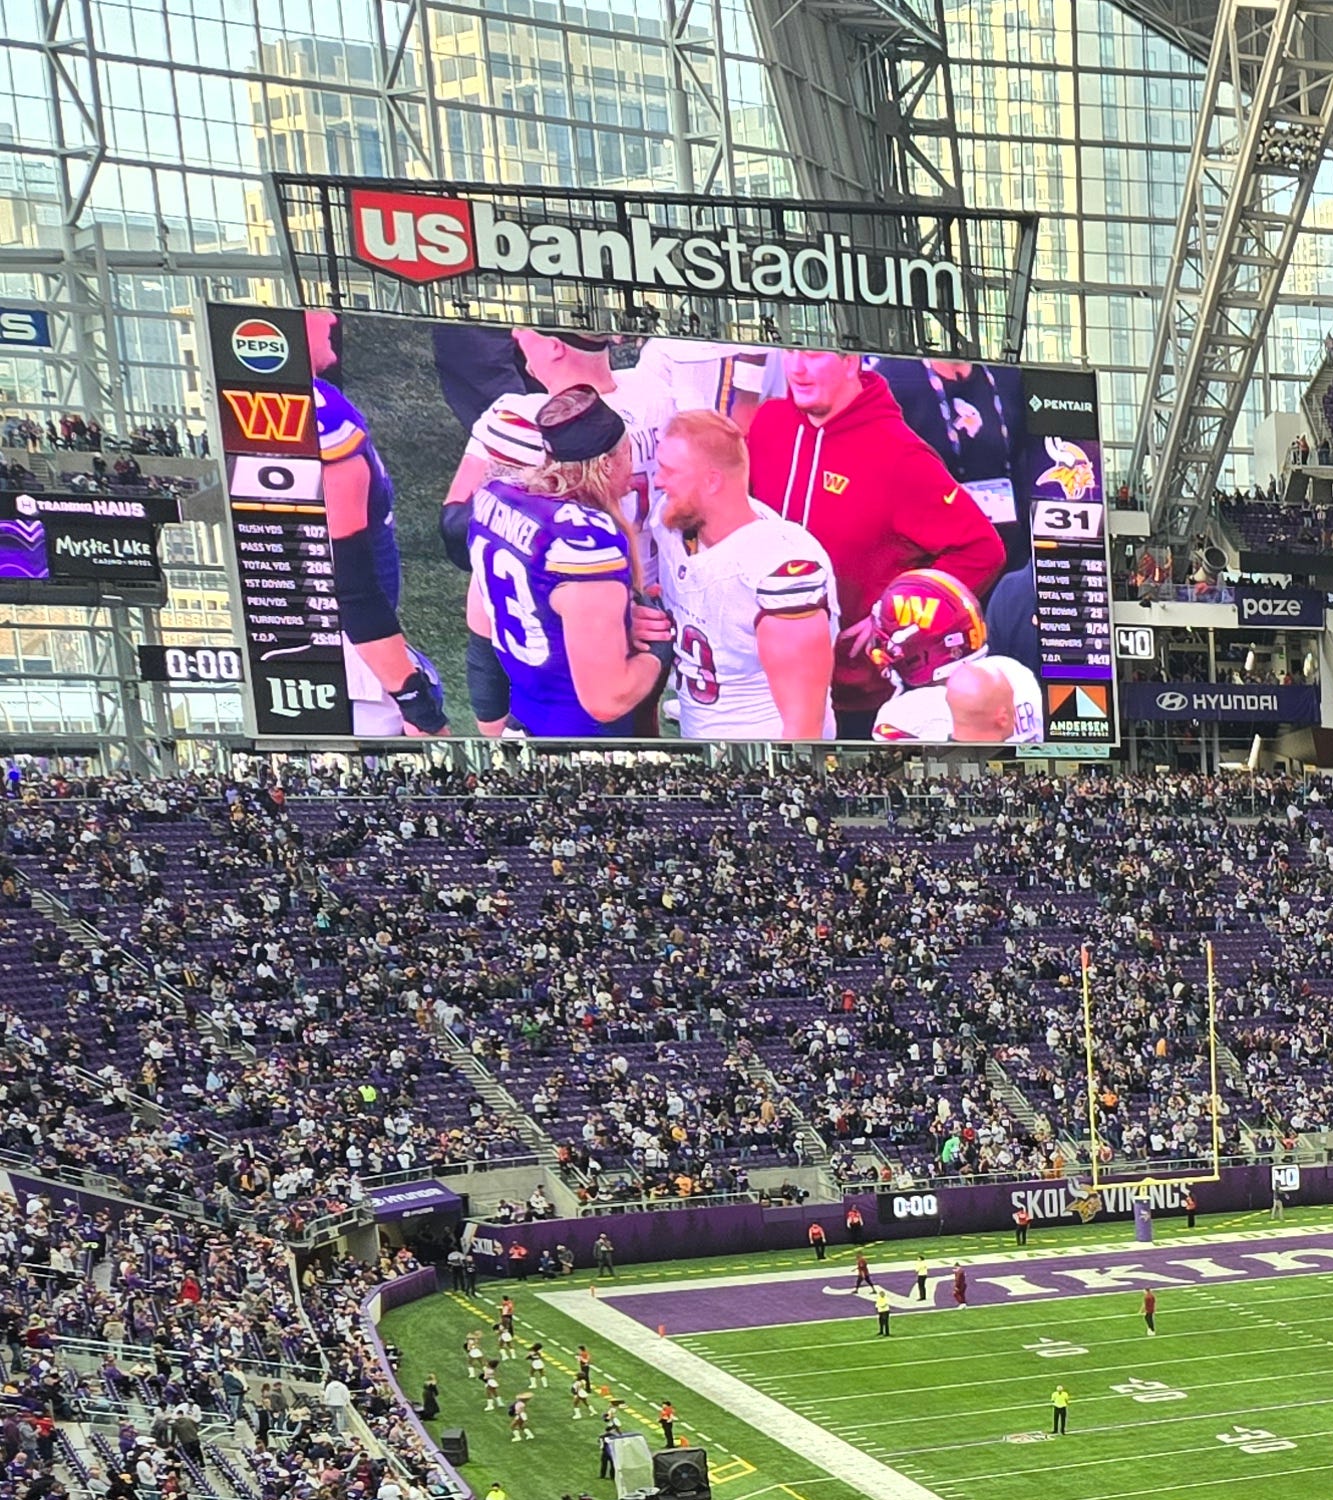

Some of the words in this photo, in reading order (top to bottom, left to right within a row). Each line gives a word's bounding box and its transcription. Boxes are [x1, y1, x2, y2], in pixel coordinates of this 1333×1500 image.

[236, 339, 285, 353] PEPSI
[1043, 399, 1093, 413] PENTAIR
[257, 466, 295, 490] 0
[93, 500, 146, 519] HAUS
[1044, 508, 1090, 530] 31
[1243, 598, 1302, 619] paze
[1119, 630, 1151, 656] 40
[165, 648, 240, 679] 0:00
[265, 676, 338, 718] Lite
[1193, 694, 1278, 711] HYUNDAI
[1050, 720, 1109, 732] ANDERSEN
[892, 1195, 938, 1217] 0:00
[1011, 1188, 1074, 1219] SKOL
[1109, 1378, 1188, 1403] 20
[1215, 1430, 1298, 1454] 30
